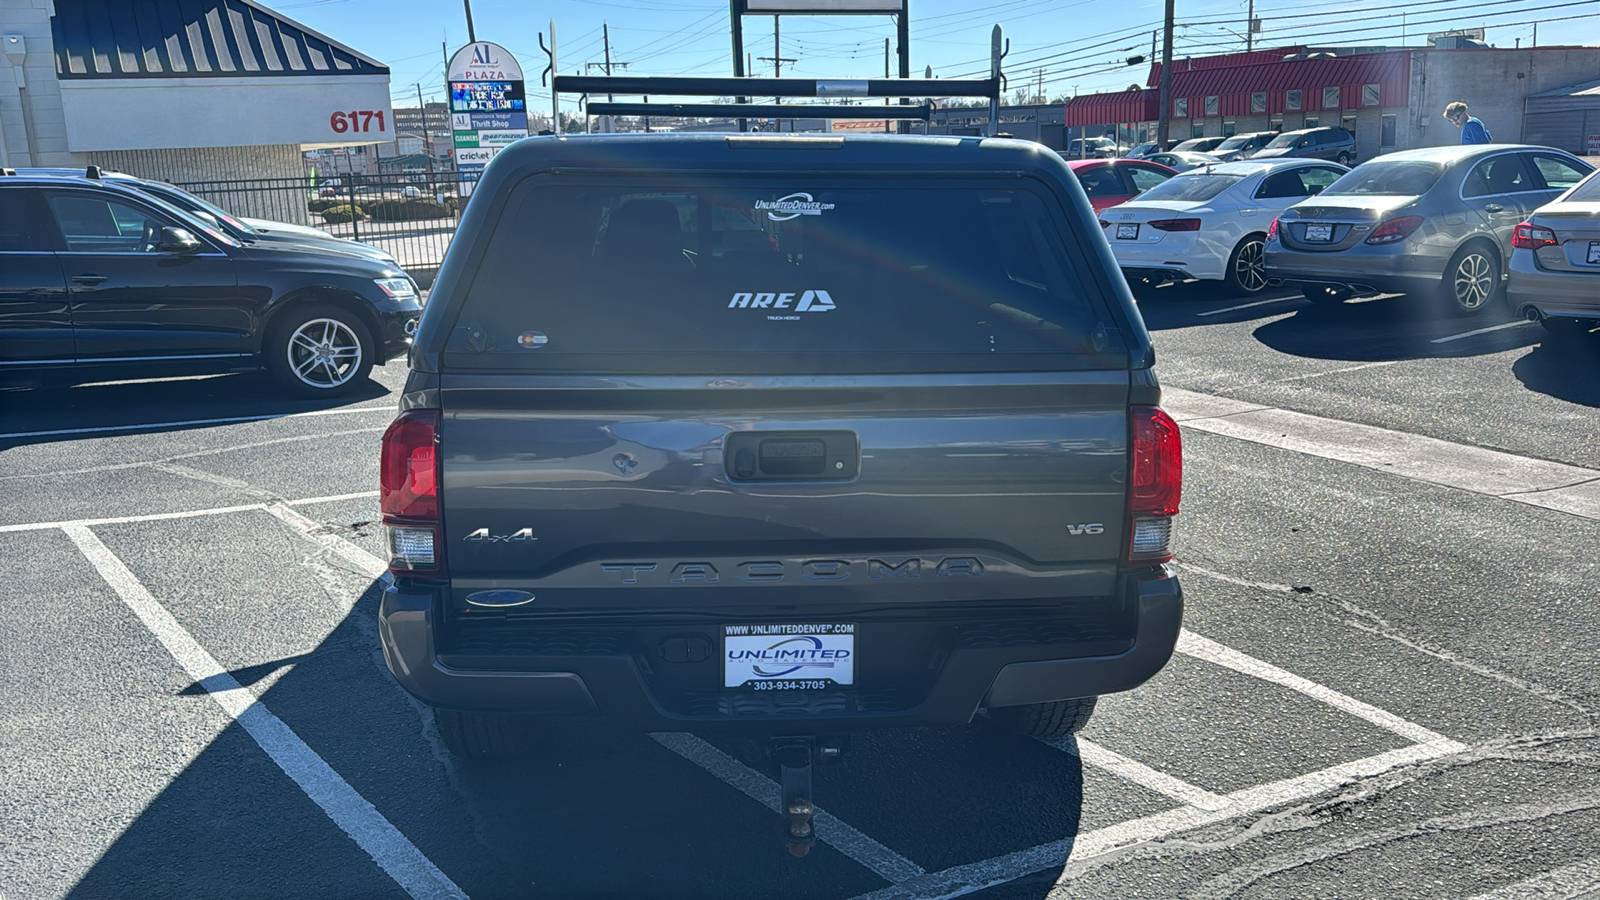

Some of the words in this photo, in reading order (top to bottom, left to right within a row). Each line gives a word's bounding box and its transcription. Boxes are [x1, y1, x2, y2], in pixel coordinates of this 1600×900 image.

[470, 45, 498, 63] AL
[465, 71, 505, 79] PLAZA
[331, 111, 385, 133] 6171
[491, 120, 510, 128] Shop
[460, 151, 490, 160] cricket
[727, 292, 797, 309] ARE
[1066, 522, 1105, 535] V6
[463, 527, 538, 543] 4x4
[601, 556, 985, 584] TACOMA
[726, 624, 854, 635] WWWUNLIMITEDDENVER.COM
[729, 650, 850, 659] UNLIMITED
[754, 681, 825, 690] 303-934-3705
